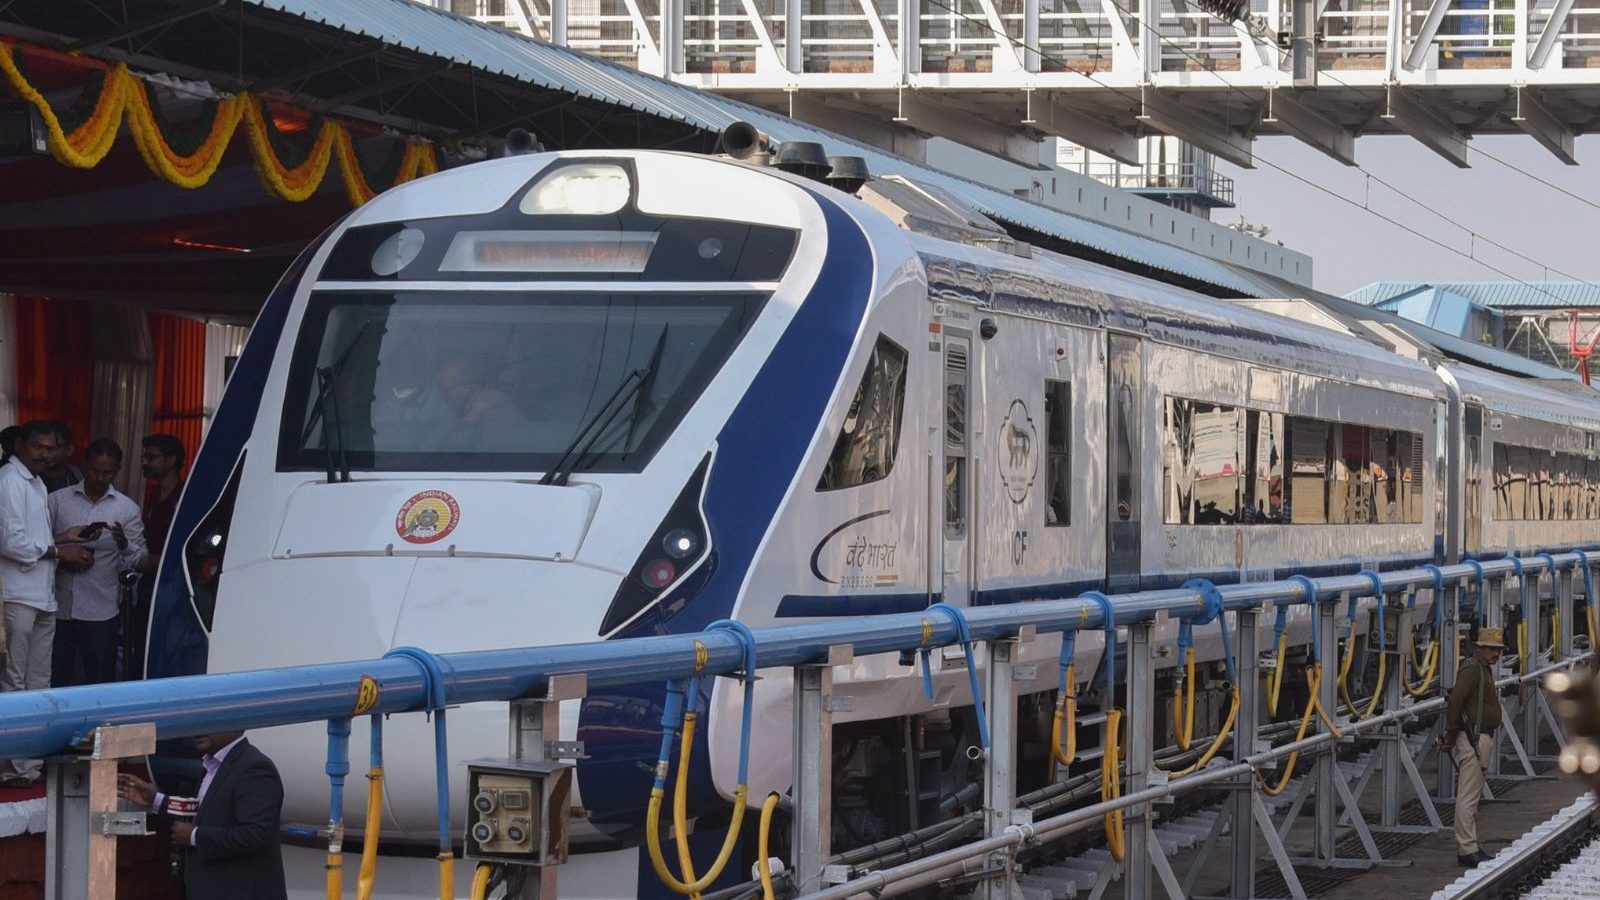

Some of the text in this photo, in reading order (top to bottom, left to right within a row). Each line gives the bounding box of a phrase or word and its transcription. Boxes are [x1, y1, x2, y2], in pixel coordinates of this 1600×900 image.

[420, 491, 448, 499] INDIAN
[846, 536, 897, 572] वंदे भारत
[1011, 531, 1027, 565] ICF
[841, 575, 873, 588] EXPRESS
